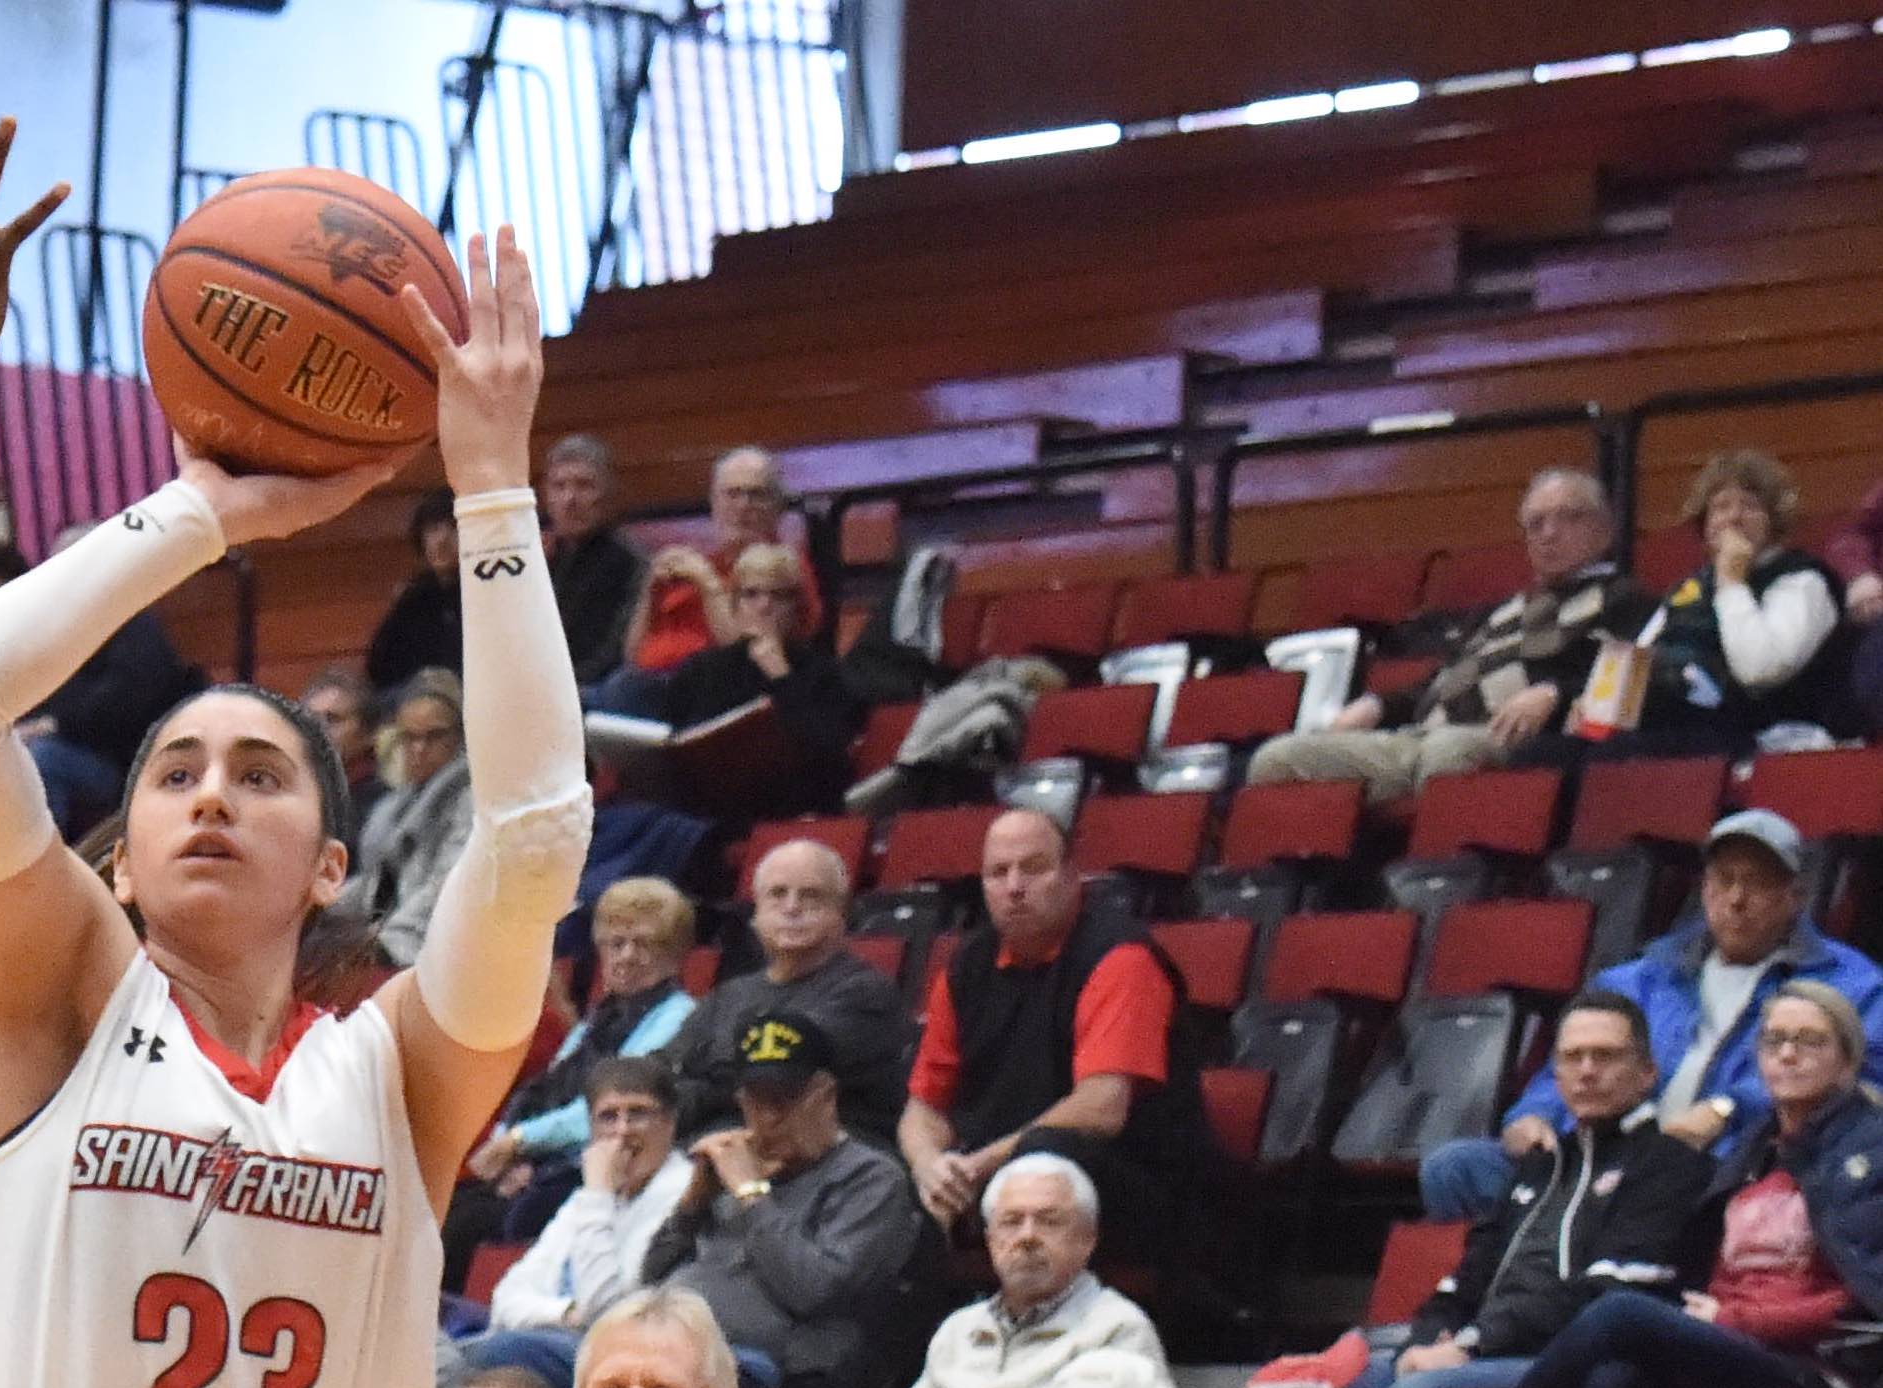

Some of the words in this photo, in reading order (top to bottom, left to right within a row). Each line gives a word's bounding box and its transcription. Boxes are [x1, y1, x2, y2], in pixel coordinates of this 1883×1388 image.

[193, 282, 290, 375] THE
[283, 330, 407, 429] ROCK
[72, 1126, 208, 1199] SAINT
[225, 1154, 386, 1232] FRANCI
